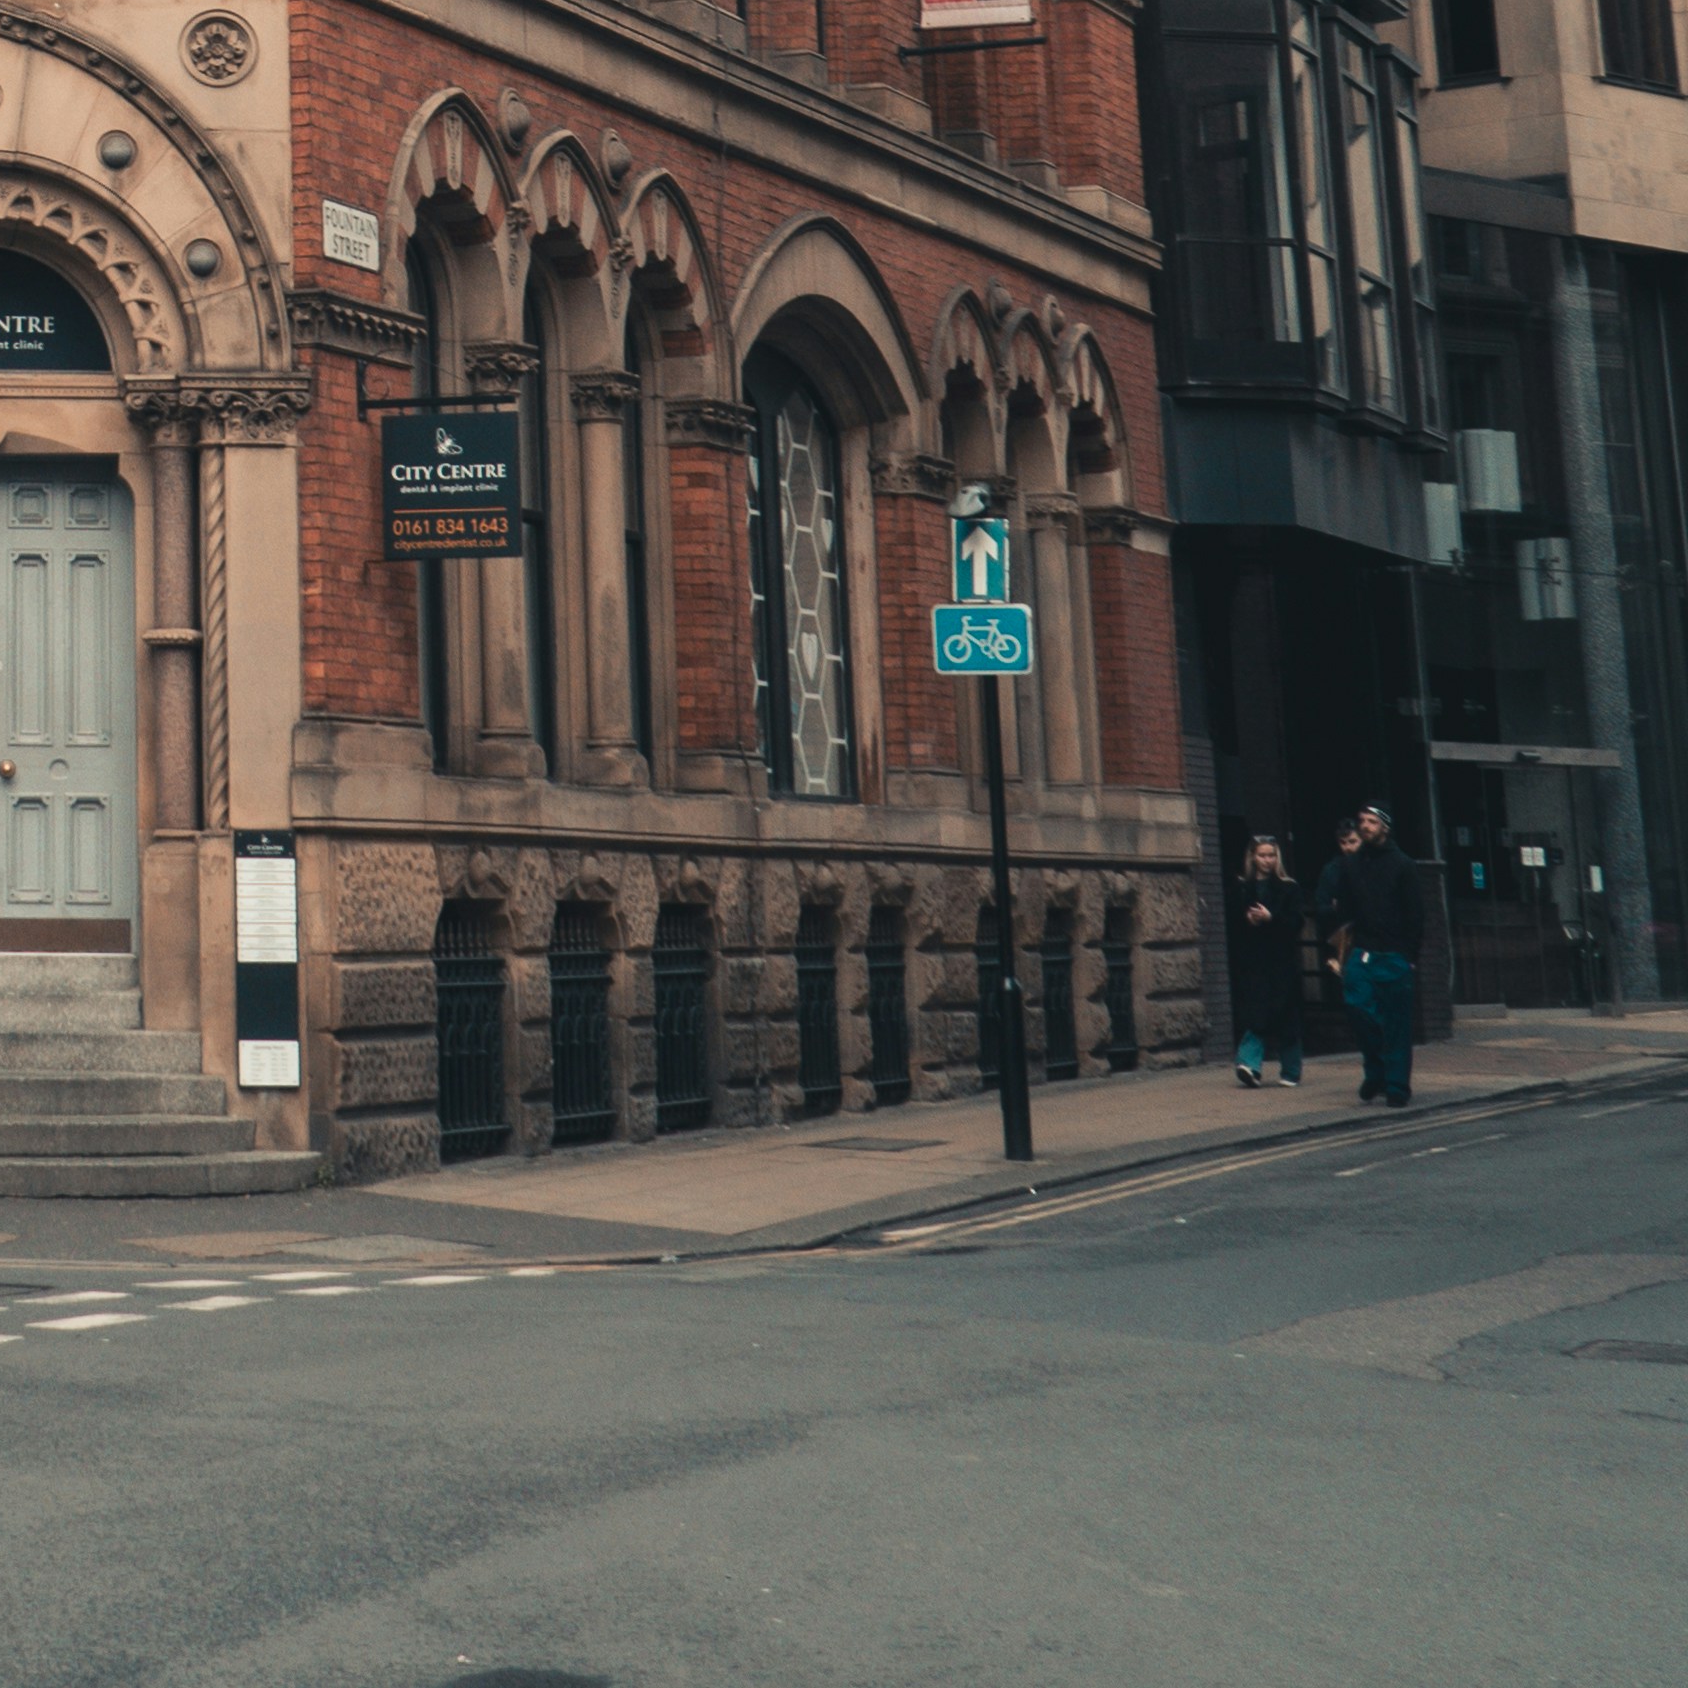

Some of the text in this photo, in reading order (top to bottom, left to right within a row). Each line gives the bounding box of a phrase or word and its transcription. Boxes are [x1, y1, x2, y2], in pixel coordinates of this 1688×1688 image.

[325, 206, 377, 240] FOUNTAIN
[333, 233, 370, 262] STREET
[13, 340, 44, 350] clinic
[400, 482, 499, 495] dental & implant clinic
[393, 517, 508, 536] 0161 834 1643
[394, 537, 508, 551] citycentredentist.co.uk
